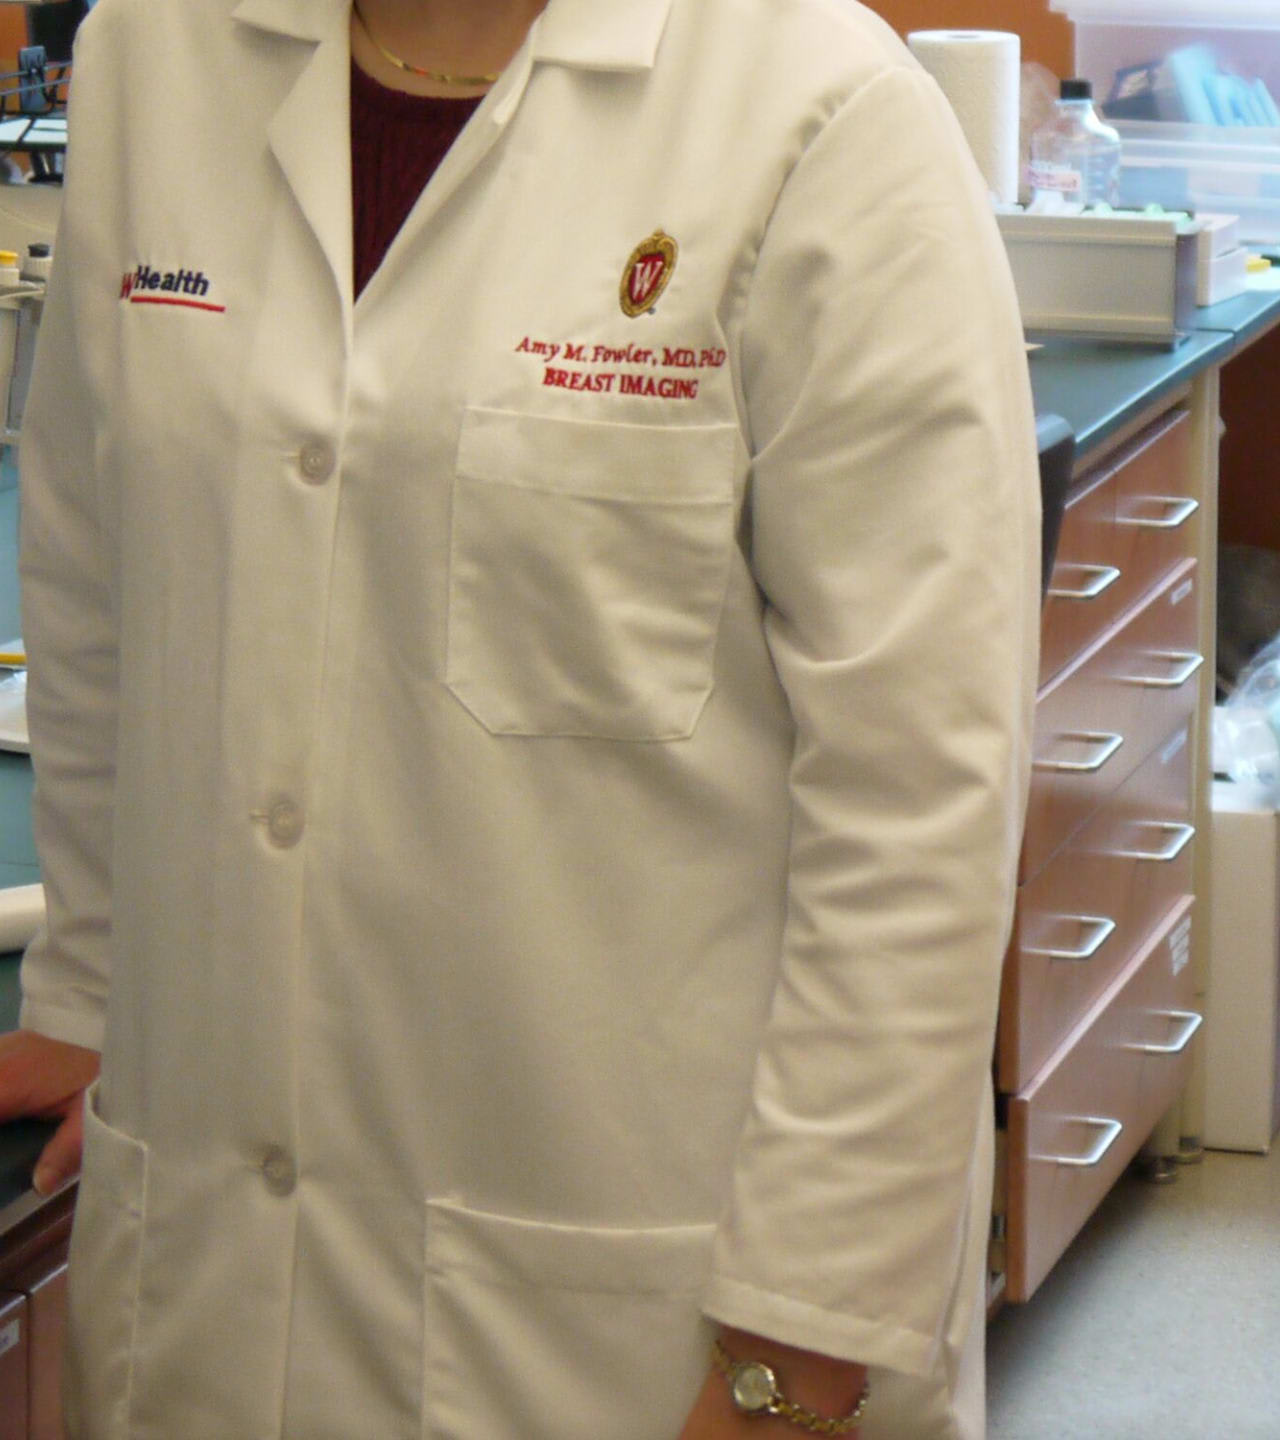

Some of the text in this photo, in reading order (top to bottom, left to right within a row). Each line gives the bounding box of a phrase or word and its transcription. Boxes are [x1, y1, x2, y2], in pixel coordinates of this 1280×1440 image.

[633, 260, 663, 298] W
[515, 336, 560, 361] Amy
[564, 342, 587, 361] M.
[592, 343, 658, 367] Fowler,
[542, 367, 699, 400] BREAST IMAGING
